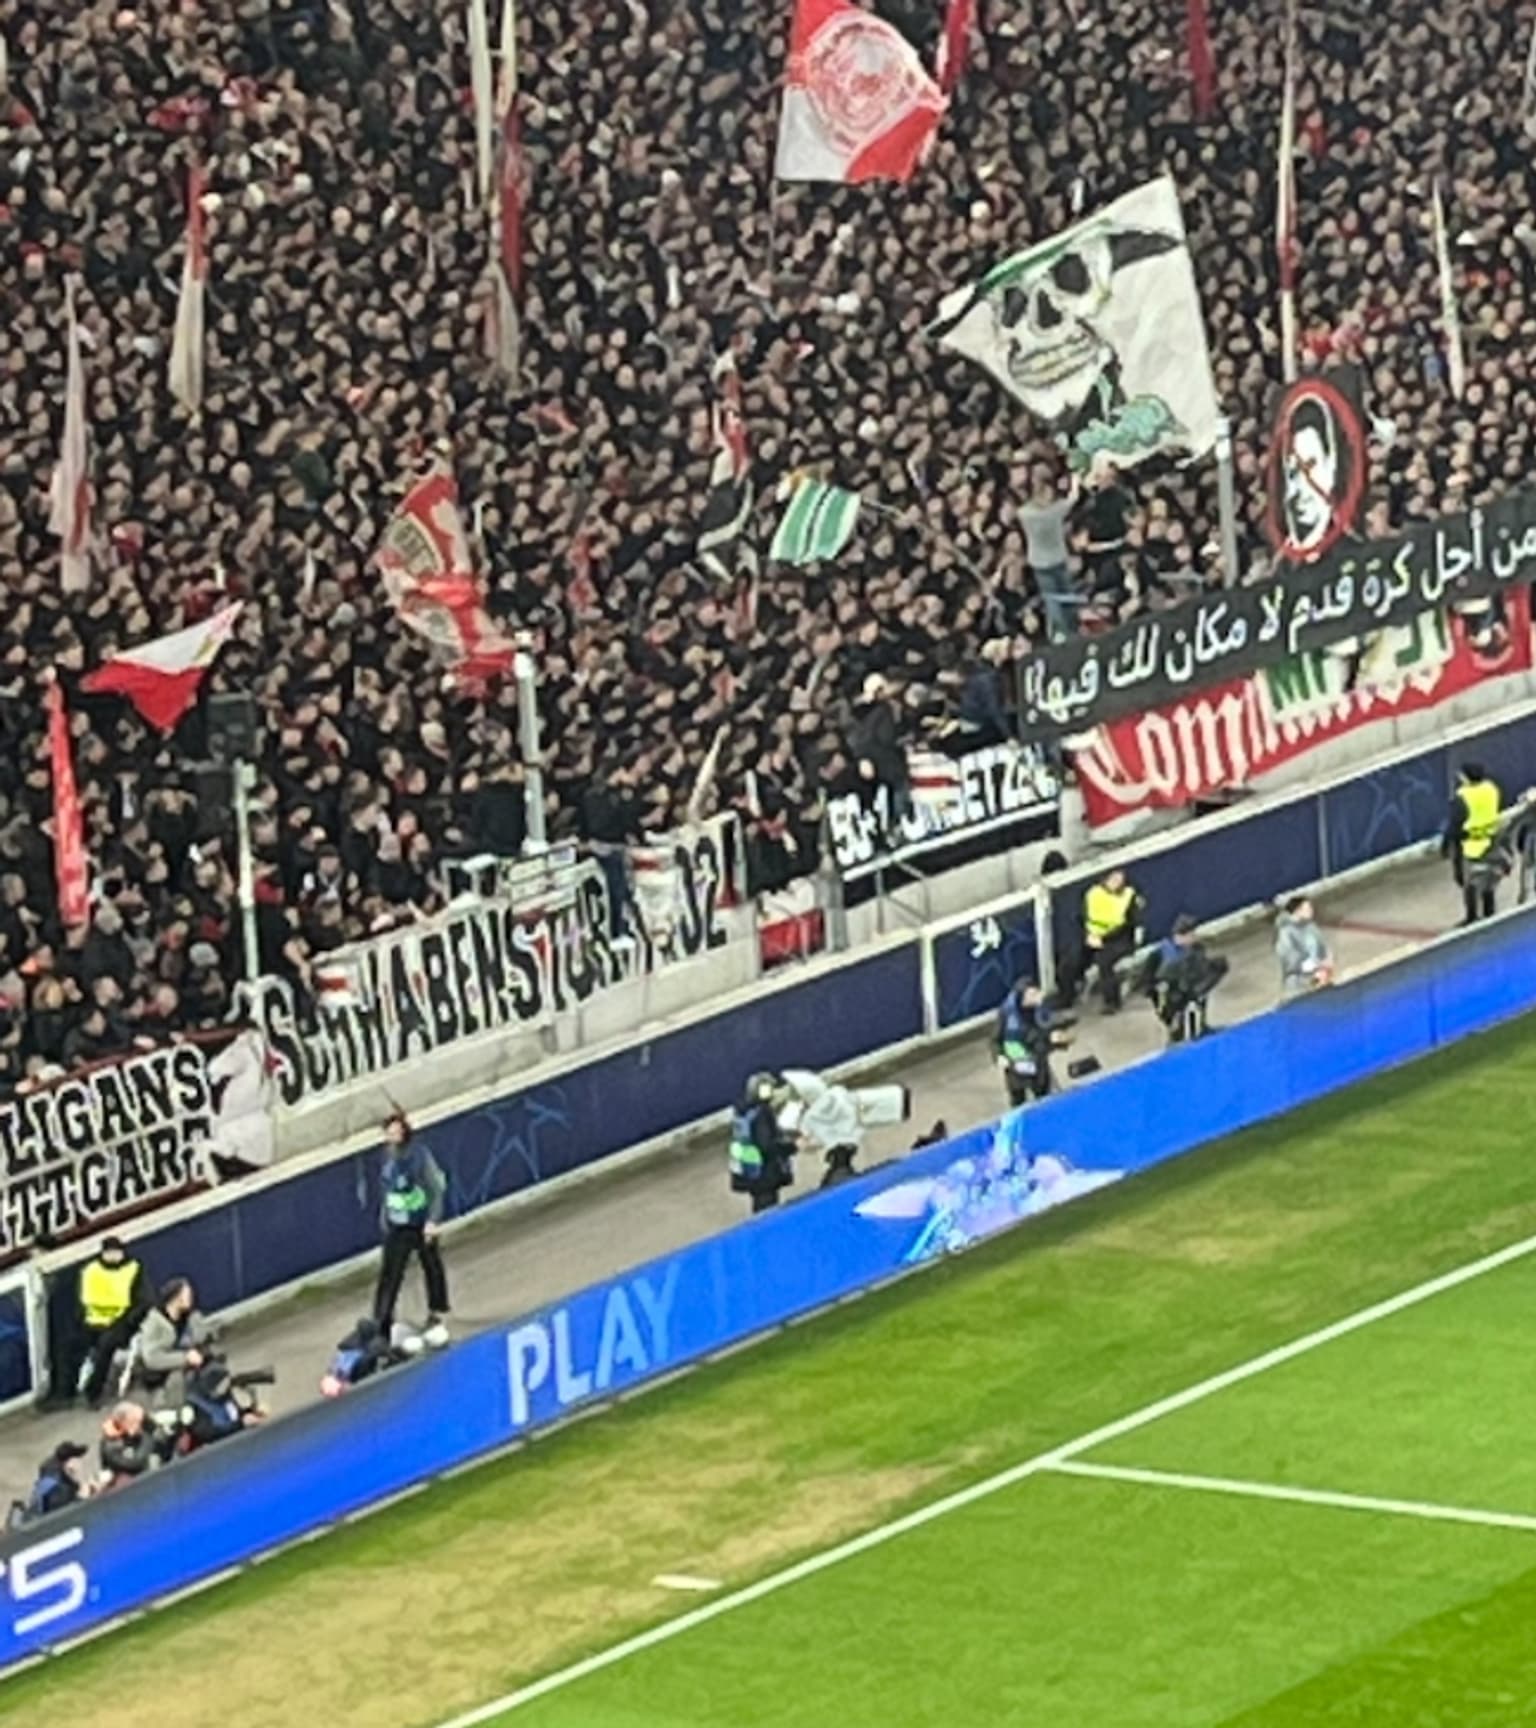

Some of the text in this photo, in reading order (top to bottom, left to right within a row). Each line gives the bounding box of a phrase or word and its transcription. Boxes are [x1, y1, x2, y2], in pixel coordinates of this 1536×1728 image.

[1362, 541, 1414, 617] كرة
[1420, 508, 1485, 601] أجل
[1164, 602, 1249, 682] مكان
[1258, 585, 1284, 641] لا
[1288, 560, 1356, 653] قدم
[1107, 623, 1160, 688] لك
[970, 917, 1001, 958] 34
[0, 1049, 208, 1175] LIGANS
[0, 1116, 210, 1247] TTGART
[507, 1262, 681, 1426] PLAY
[0, 1527, 87, 1636] 5
